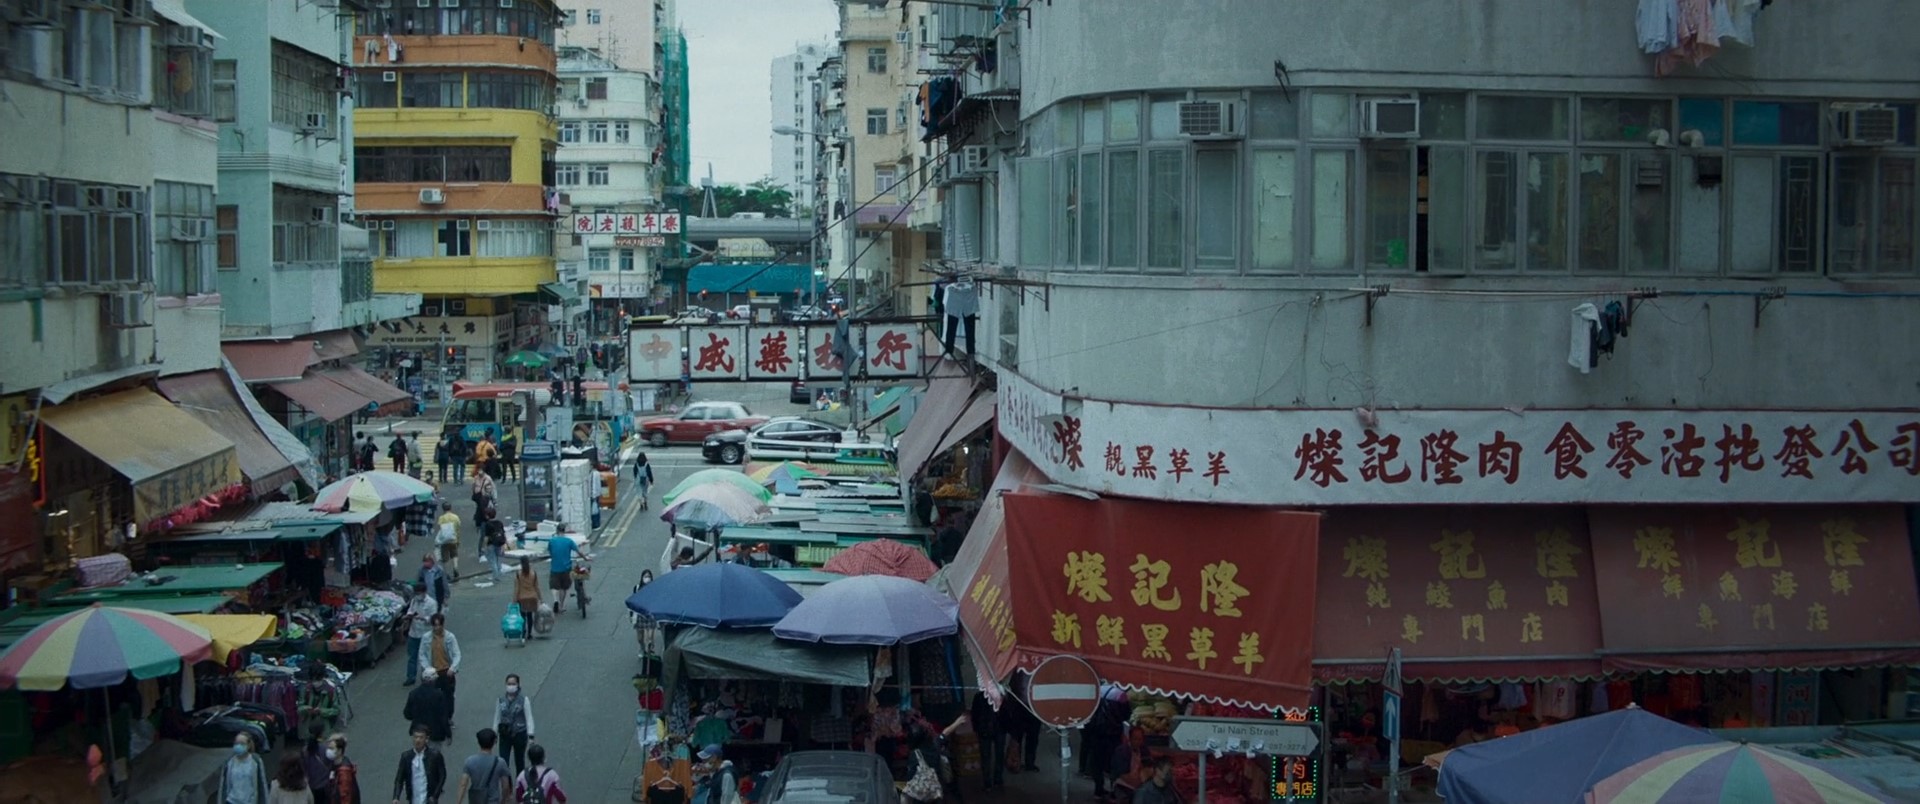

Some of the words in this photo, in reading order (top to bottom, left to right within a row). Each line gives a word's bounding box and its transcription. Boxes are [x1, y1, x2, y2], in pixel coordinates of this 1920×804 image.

[1104, 441, 1231, 487] 靚黑草羊
[1343, 527, 1584, 581] 燦記隆
[1633, 517, 1869, 573] 燦記隆
[1063, 550, 1251, 618] 燦記隆
[1050, 609, 1265, 675] 新鮮黑草羊
[1401, 611, 1543, 645] 專門店
[1696, 602, 1829, 633] 專門店
[1212, 725, 1225, 734] Tai
[1228, 725, 1247, 735] Nan
[1249, 727, 1279, 737] Street
